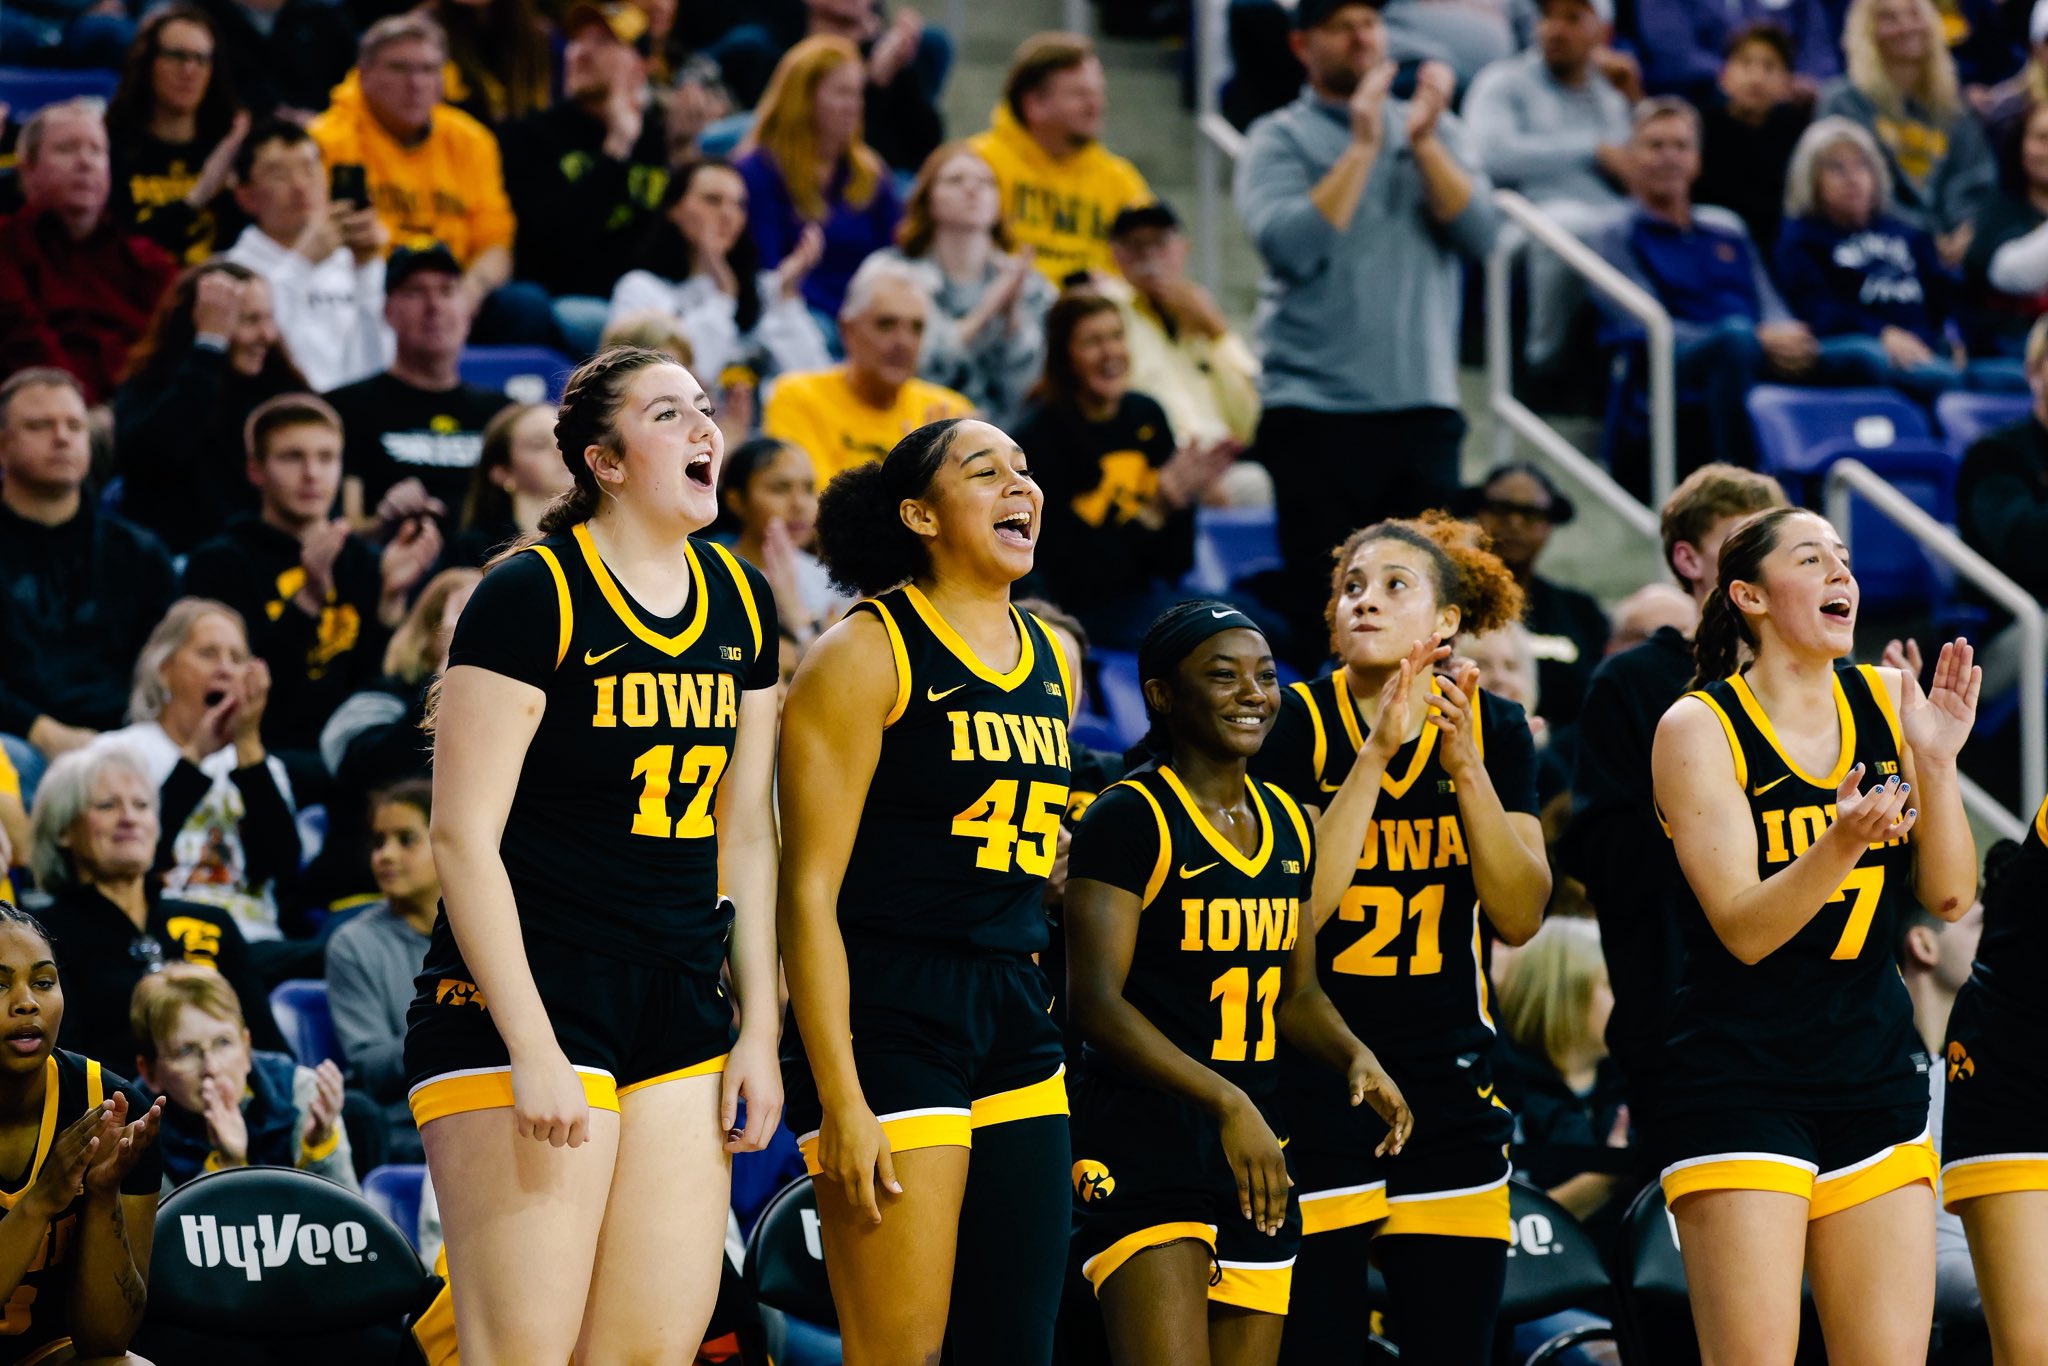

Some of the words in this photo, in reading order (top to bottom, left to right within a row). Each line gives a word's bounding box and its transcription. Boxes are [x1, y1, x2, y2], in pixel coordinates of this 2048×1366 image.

[592, 672, 737, 728] IOWA
[947, 711, 1071, 772] IOWA
[631, 745, 727, 838] 12
[951, 779, 1069, 879] 45
[1356, 815, 1468, 871] OWA
[1181, 898, 1299, 951] IOWA
[1332, 884, 1445, 976] 21
[1826, 865, 1885, 960] 7
[1210, 967, 1281, 1061] 11
[180, 1214, 367, 1281] HyVee
